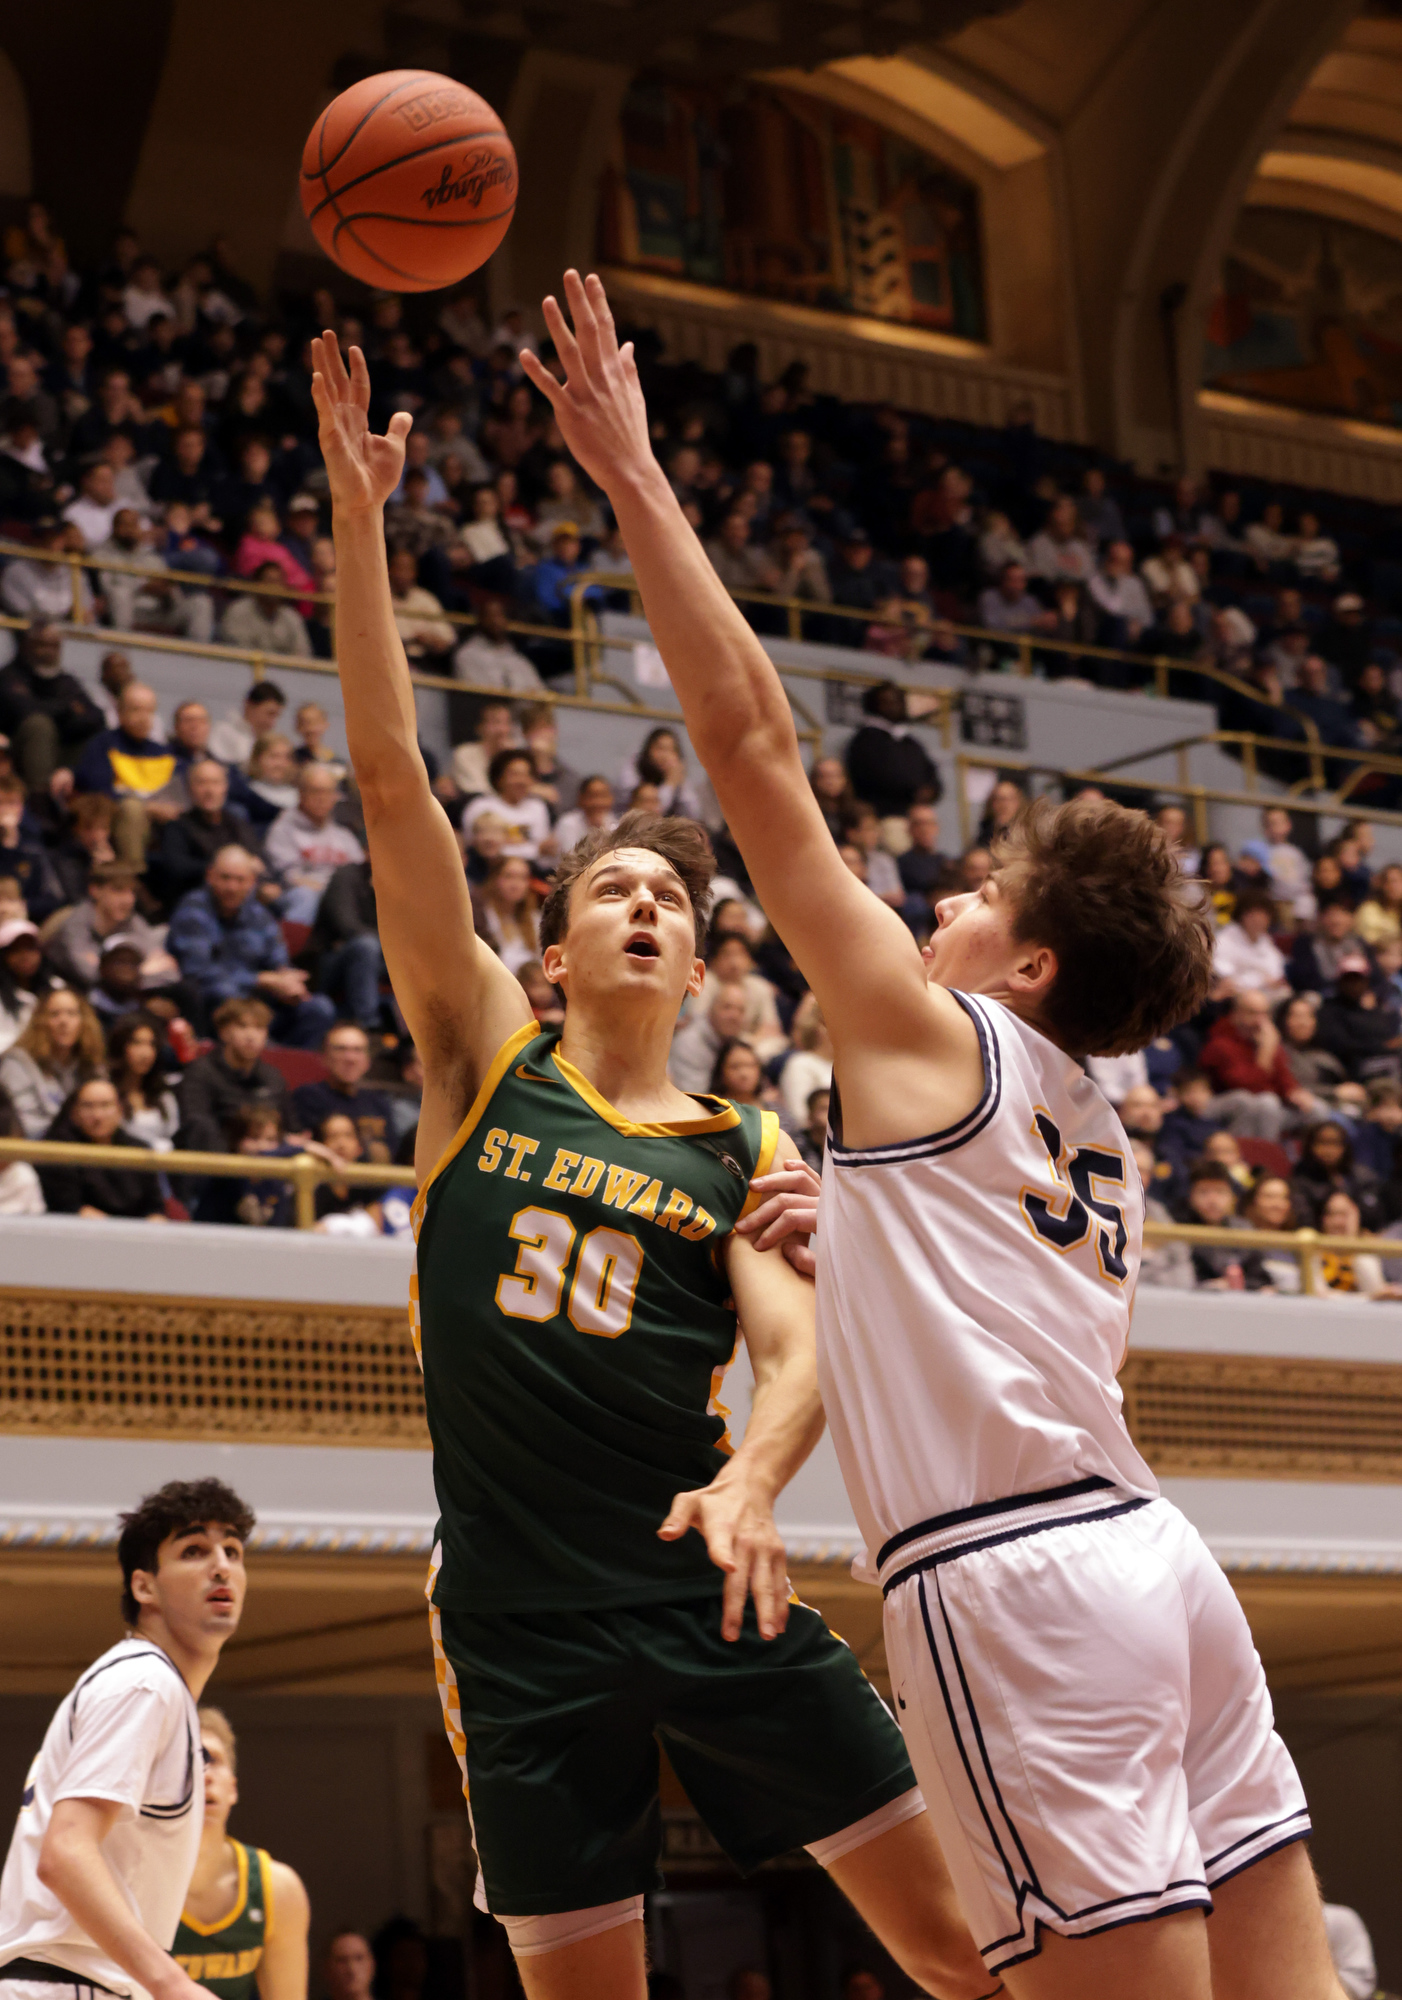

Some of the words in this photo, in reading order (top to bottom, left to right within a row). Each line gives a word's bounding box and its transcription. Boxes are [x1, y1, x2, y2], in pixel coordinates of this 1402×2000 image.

[478, 1127, 540, 1182] ST.
[542, 1147, 717, 1241] EDWARD
[1018, 1105, 1130, 1287] 35
[494, 1205, 644, 1339] 30
